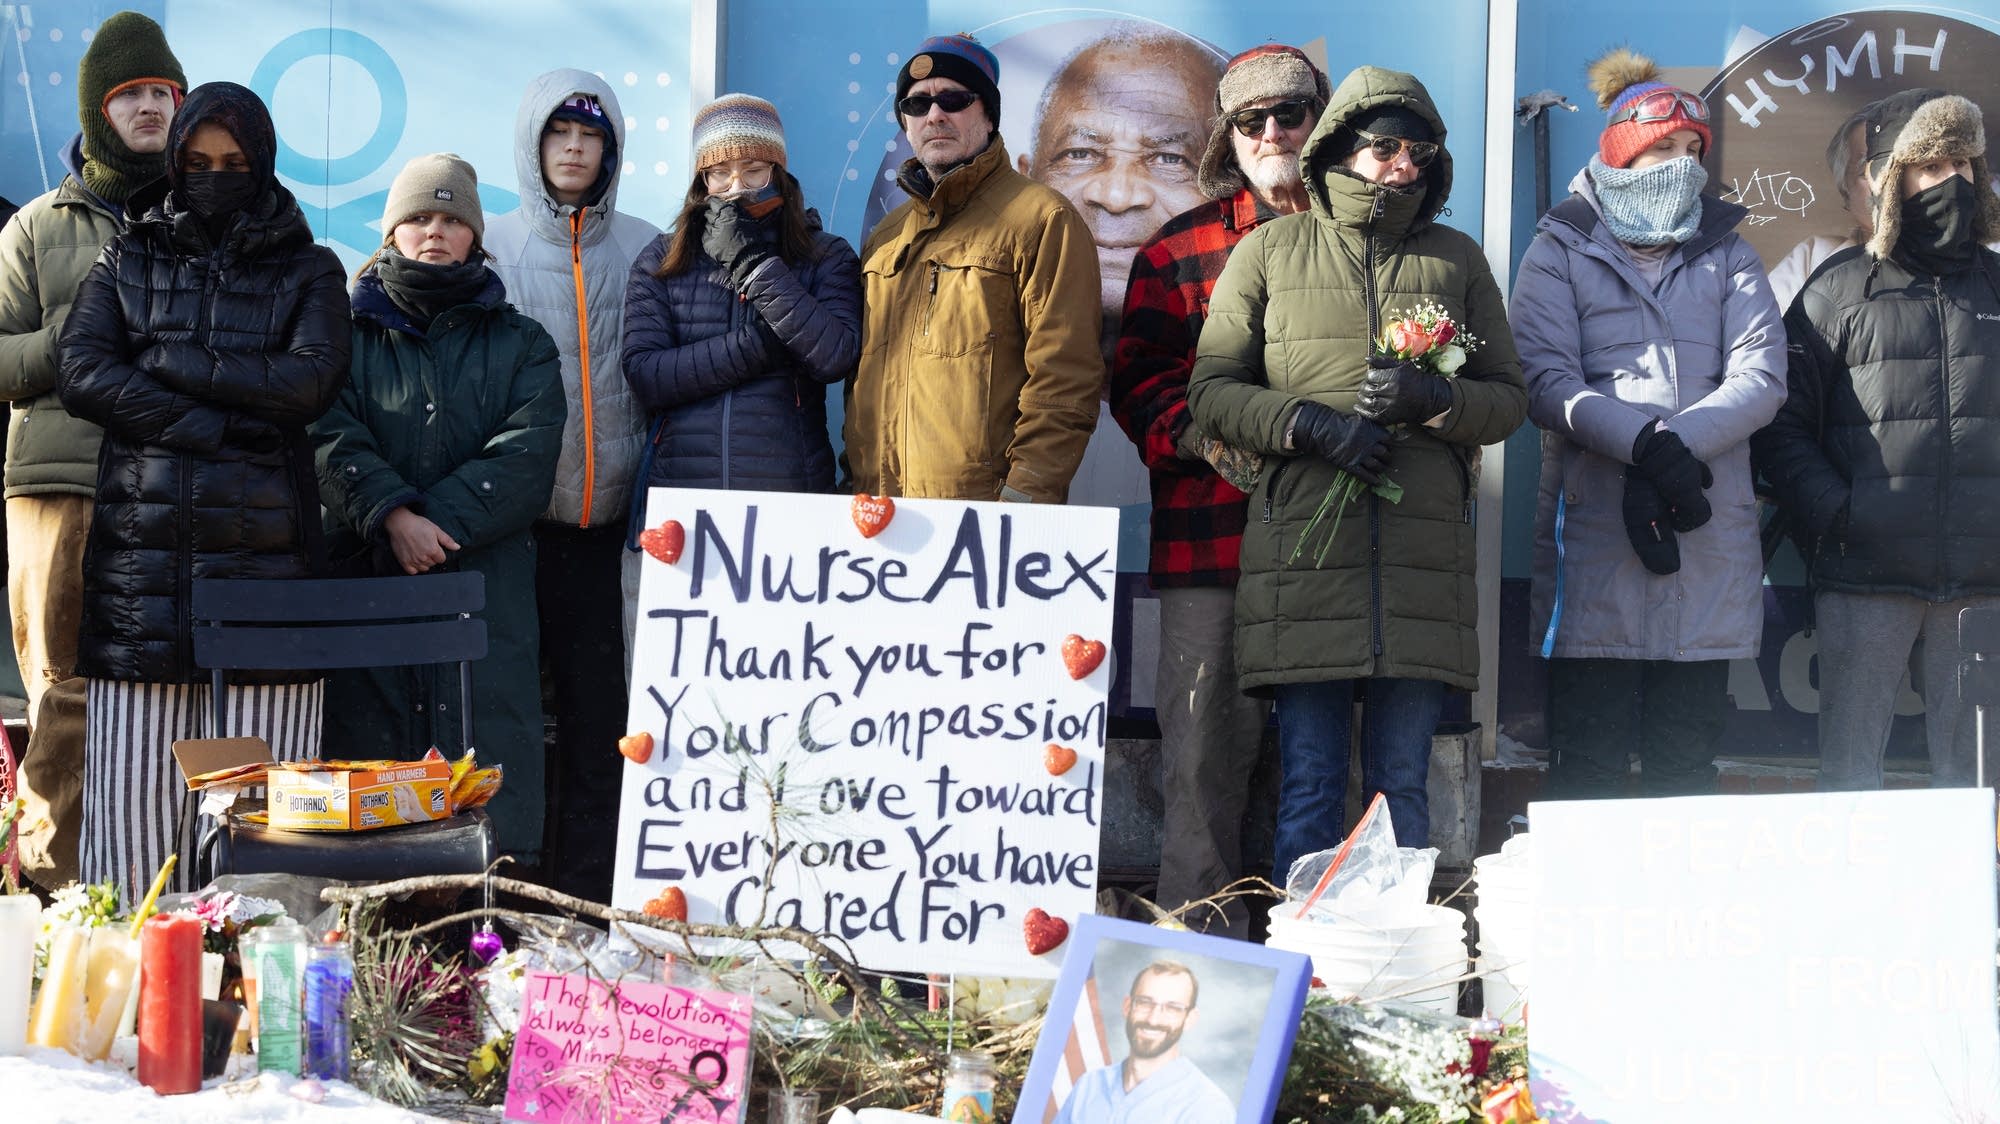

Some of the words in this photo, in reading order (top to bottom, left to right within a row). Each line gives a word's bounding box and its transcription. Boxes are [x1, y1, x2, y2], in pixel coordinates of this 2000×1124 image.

[857, 500, 886, 516] LOVE
[859, 511, 881, 525] YOU
[690, 505, 922, 604] Nurse
[647, 609, 834, 681] Thank
[846, 643, 942, 698] you
[944, 622, 1045, 680] for
[647, 684, 788, 762] Your
[800, 692, 1106, 761] Compassion
[275, 790, 284, 804] 8
[376, 770, 395, 783] HAND
[396, 767, 427, 780] WARMERS
[644, 765, 749, 812] and
[925, 762, 1096, 826] toward
[635, 819, 893, 880] Everyone
[905, 824, 987, 883] You
[994, 826, 1094, 889] have
[1641, 812, 1888, 873] PEACE
[725, 870, 906, 943] Cared
[919, 880, 1005, 944] For
[1538, 903, 1764, 961] STEMS
[533, 975, 589, 1010] The
[1786, 956, 1990, 1013] FROM
[524, 1034, 548, 1059] to
[528, 1010, 610, 1042] always
[629, 1019, 730, 1062] belonged
[1604, 1047, 1915, 1105] JUSTICE
